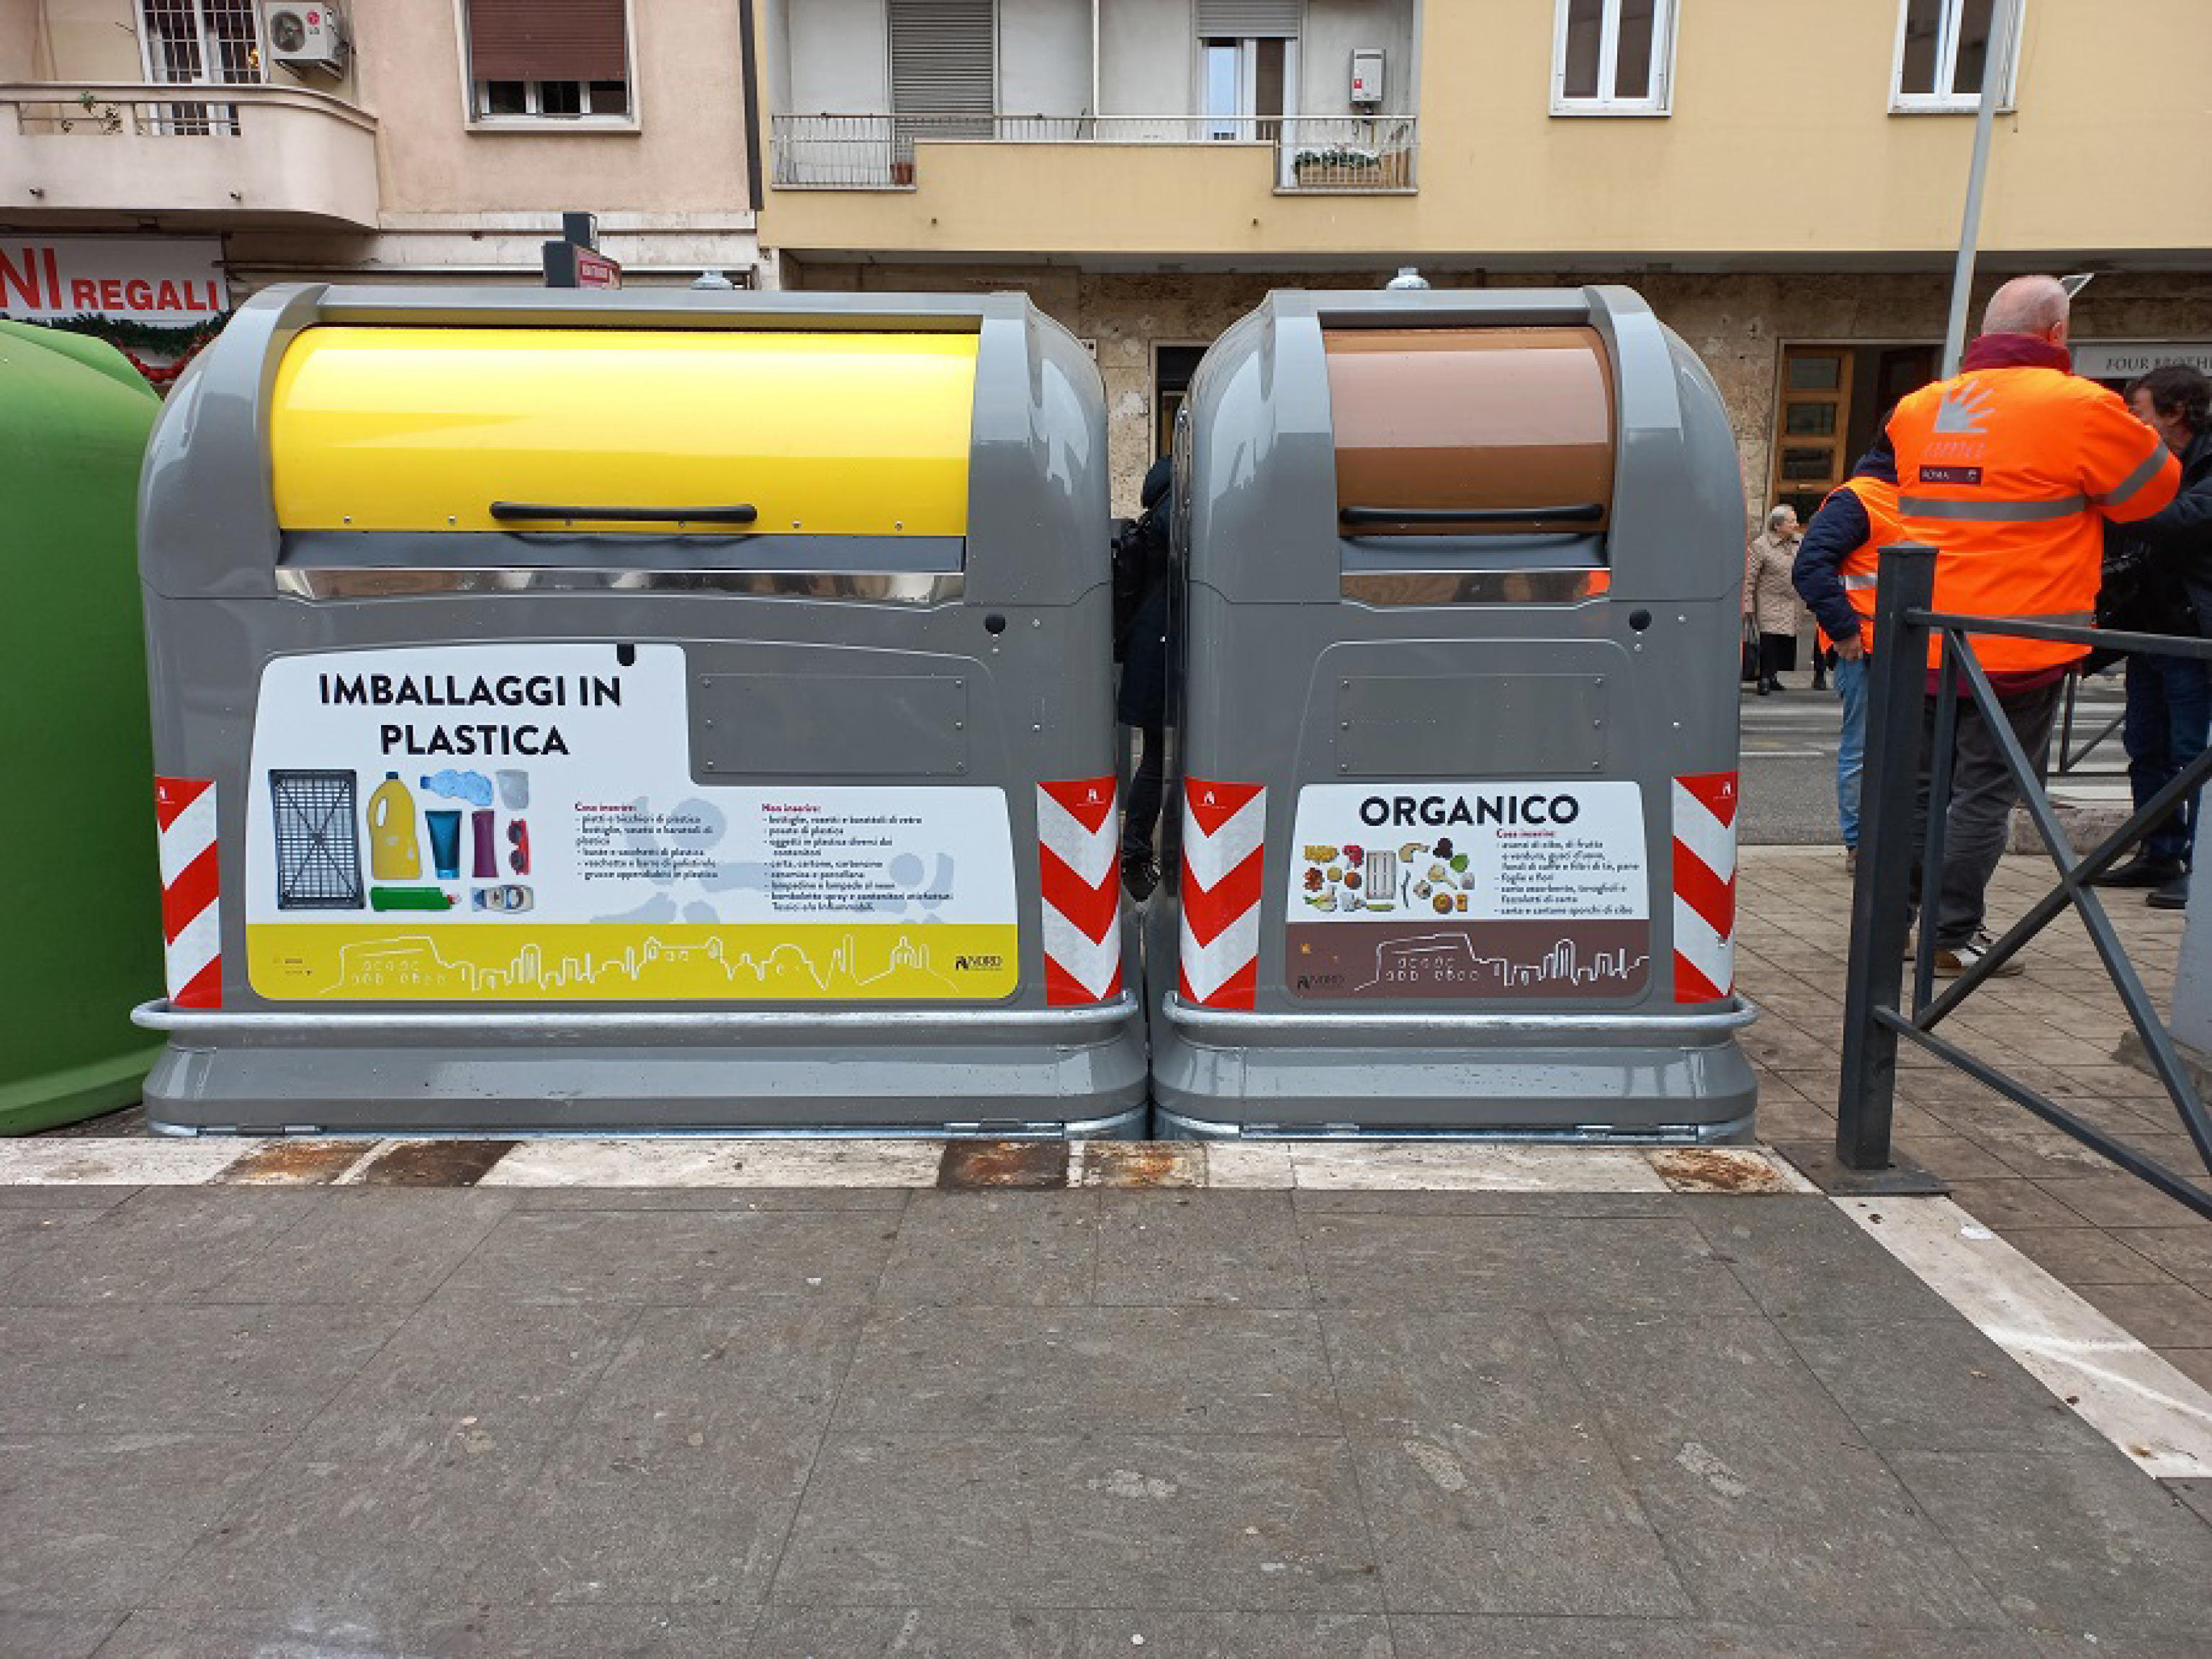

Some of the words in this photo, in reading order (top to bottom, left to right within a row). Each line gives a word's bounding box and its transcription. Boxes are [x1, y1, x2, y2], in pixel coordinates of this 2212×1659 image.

[71, 279, 219, 310] REGALI
[319, 673, 567, 706] IMBALLAGGI
[580, 675, 622, 706] IN
[380, 724, 570, 756] PLASTICA
[1359, 795, 1580, 826] ORGANICO
